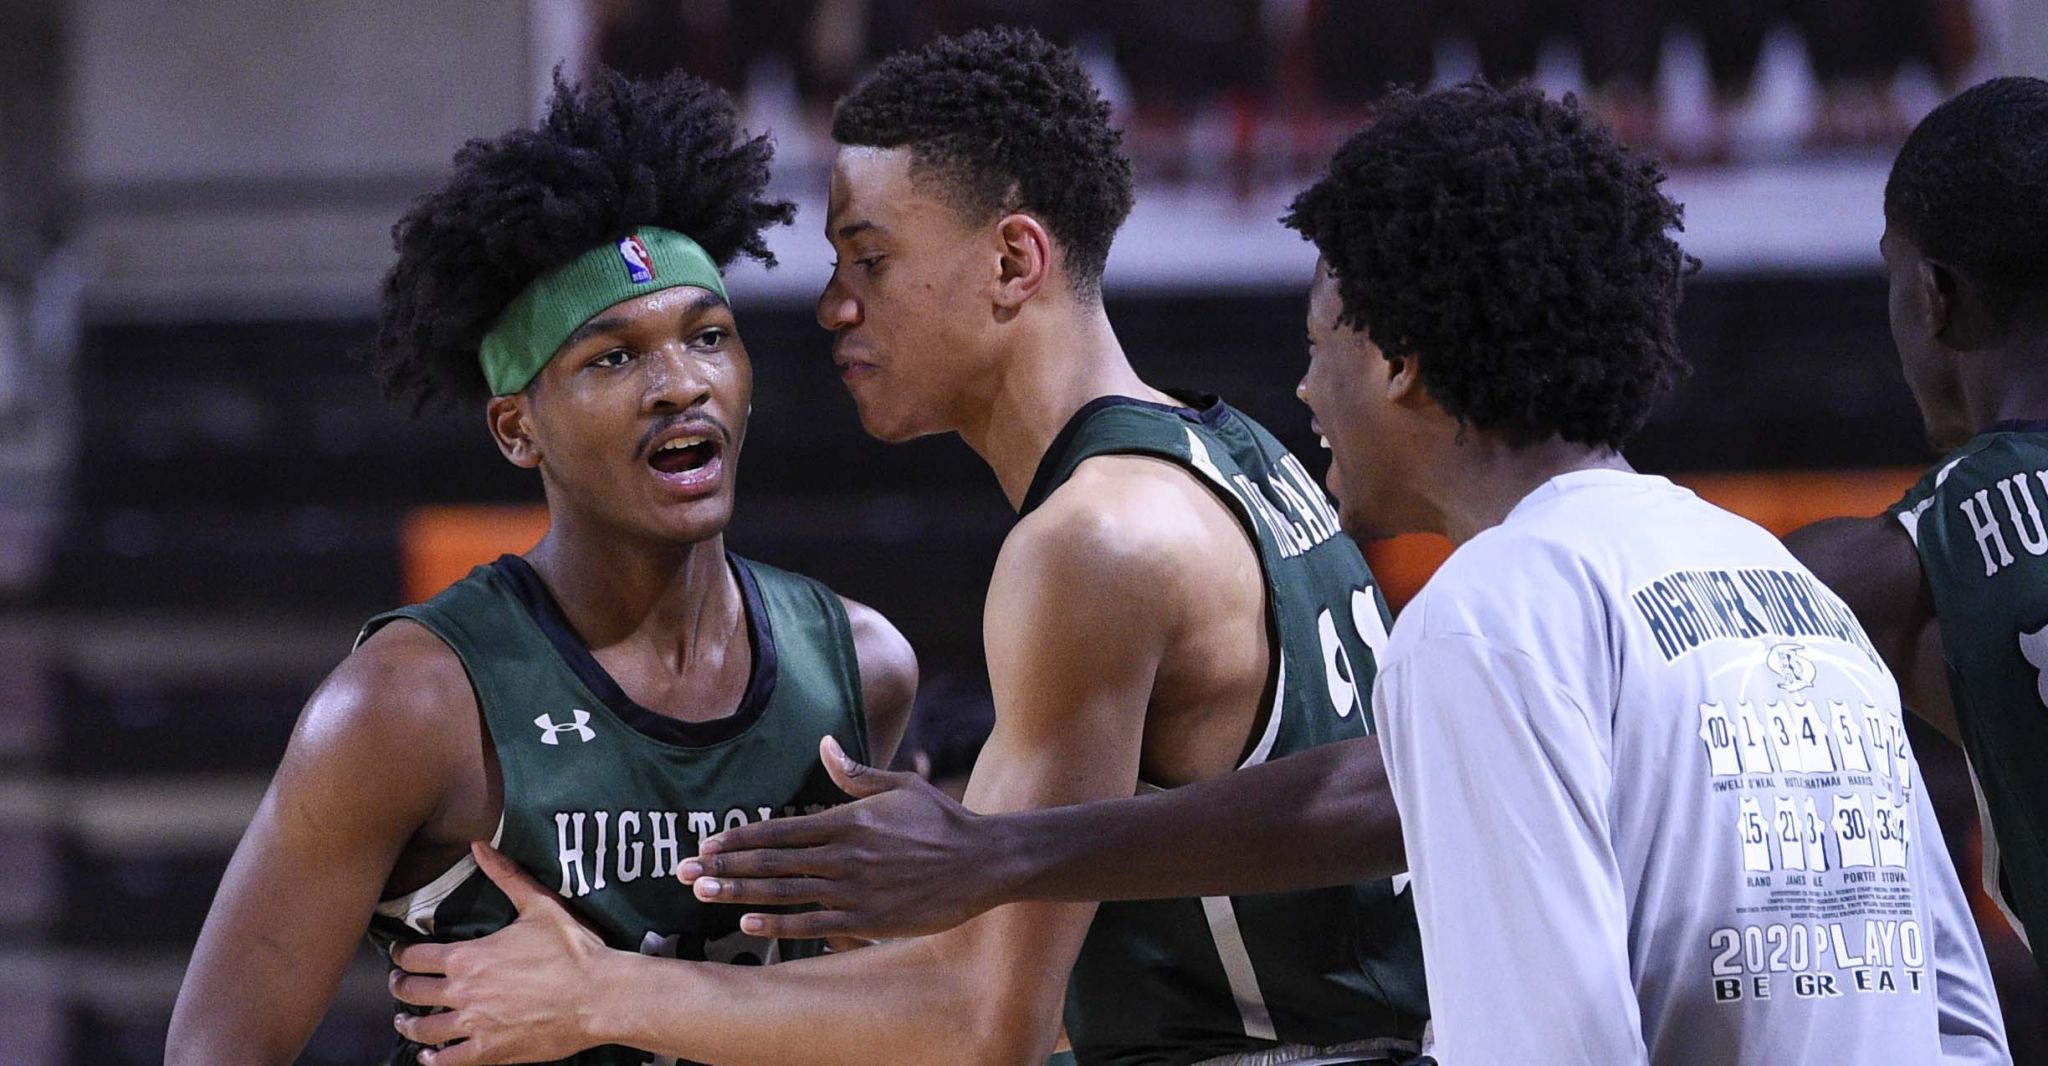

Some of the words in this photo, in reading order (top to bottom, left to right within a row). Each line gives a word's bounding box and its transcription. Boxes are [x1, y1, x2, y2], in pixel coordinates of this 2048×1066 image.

[1737, 569, 1883, 674] HURRICA
[1707, 716, 1729, 749] 00
[1742, 715, 1756, 746] 1
[1773, 716, 1790, 746] 3
[1801, 716, 1817, 746] 4
[1839, 714, 1853, 745] 5
[1866, 717, 1884, 749] 11
[1743, 812, 1763, 844] 15
[1779, 811, 1799, 842] 21
[1838, 808, 1866, 840] 30
[554, 803, 846, 899] HIGHT
[1709, 922, 1810, 977] 2020
[1815, 919, 1925, 970] PLAYO
[1714, 974, 1771, 1002] BE
[1794, 968, 1924, 998] GREAT
